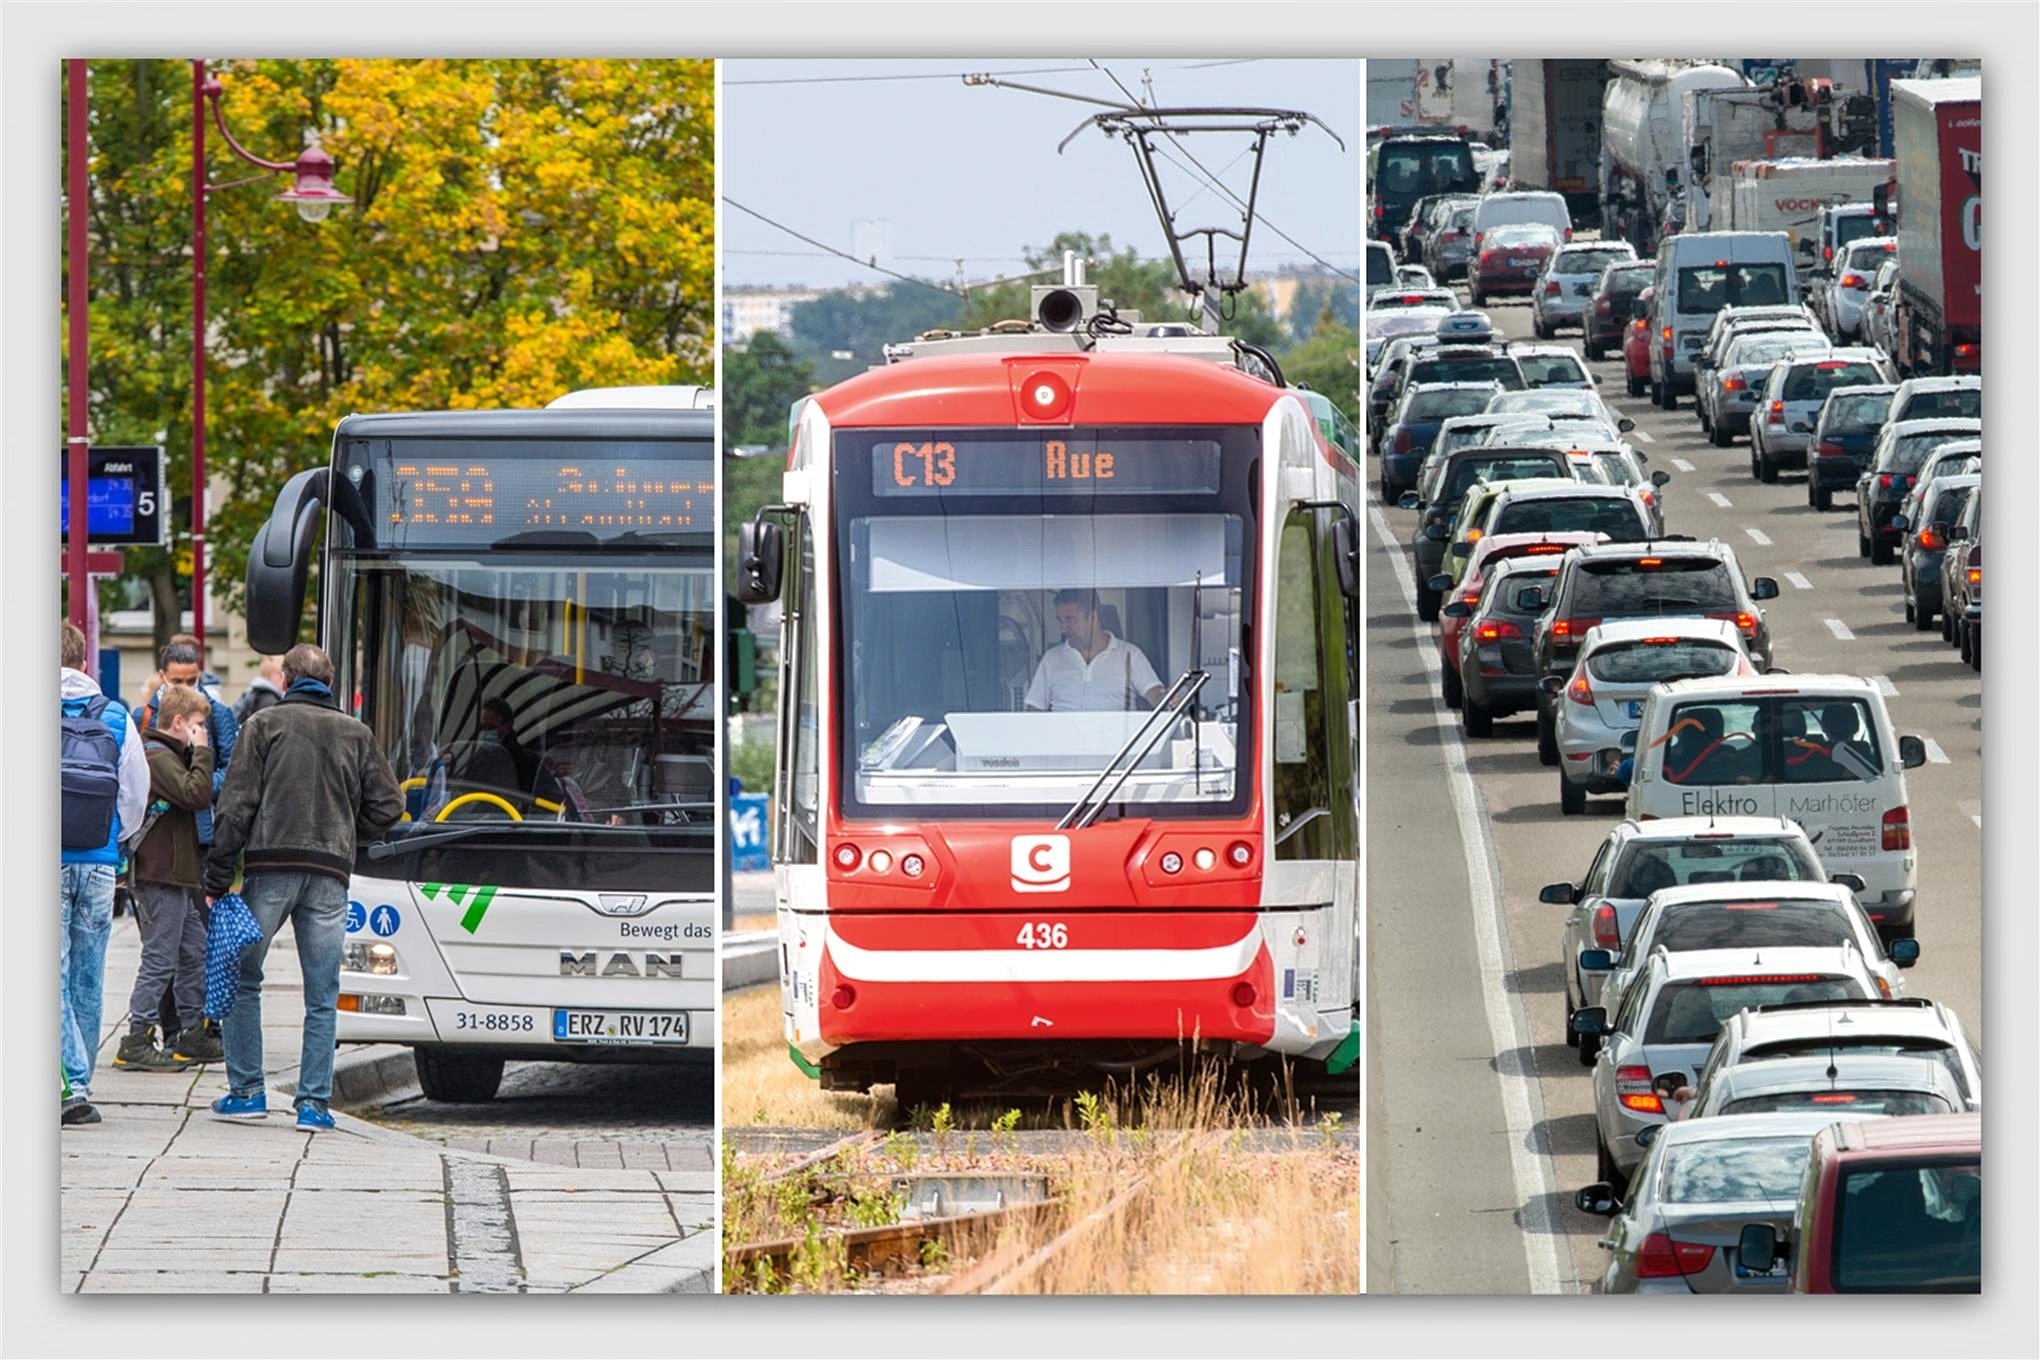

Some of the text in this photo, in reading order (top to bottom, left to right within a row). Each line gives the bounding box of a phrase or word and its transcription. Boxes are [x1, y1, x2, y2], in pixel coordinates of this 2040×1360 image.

[894, 440, 1115, 486] C13 Aue
[138, 491, 155, 516] 5
[1681, 791, 1878, 815] Elektro Marhöfer
[1028, 843, 1053, 870] C
[620, 922, 712, 939] Bewegt das
[1016, 922, 1068, 949] 436
[559, 950, 684, 978] MAN
[456, 1011, 534, 1032] 31-8858
[568, 1014, 606, 1036] ERZ
[619, 1015, 645, 1037] RV
[648, 1016, 685, 1038] 174
